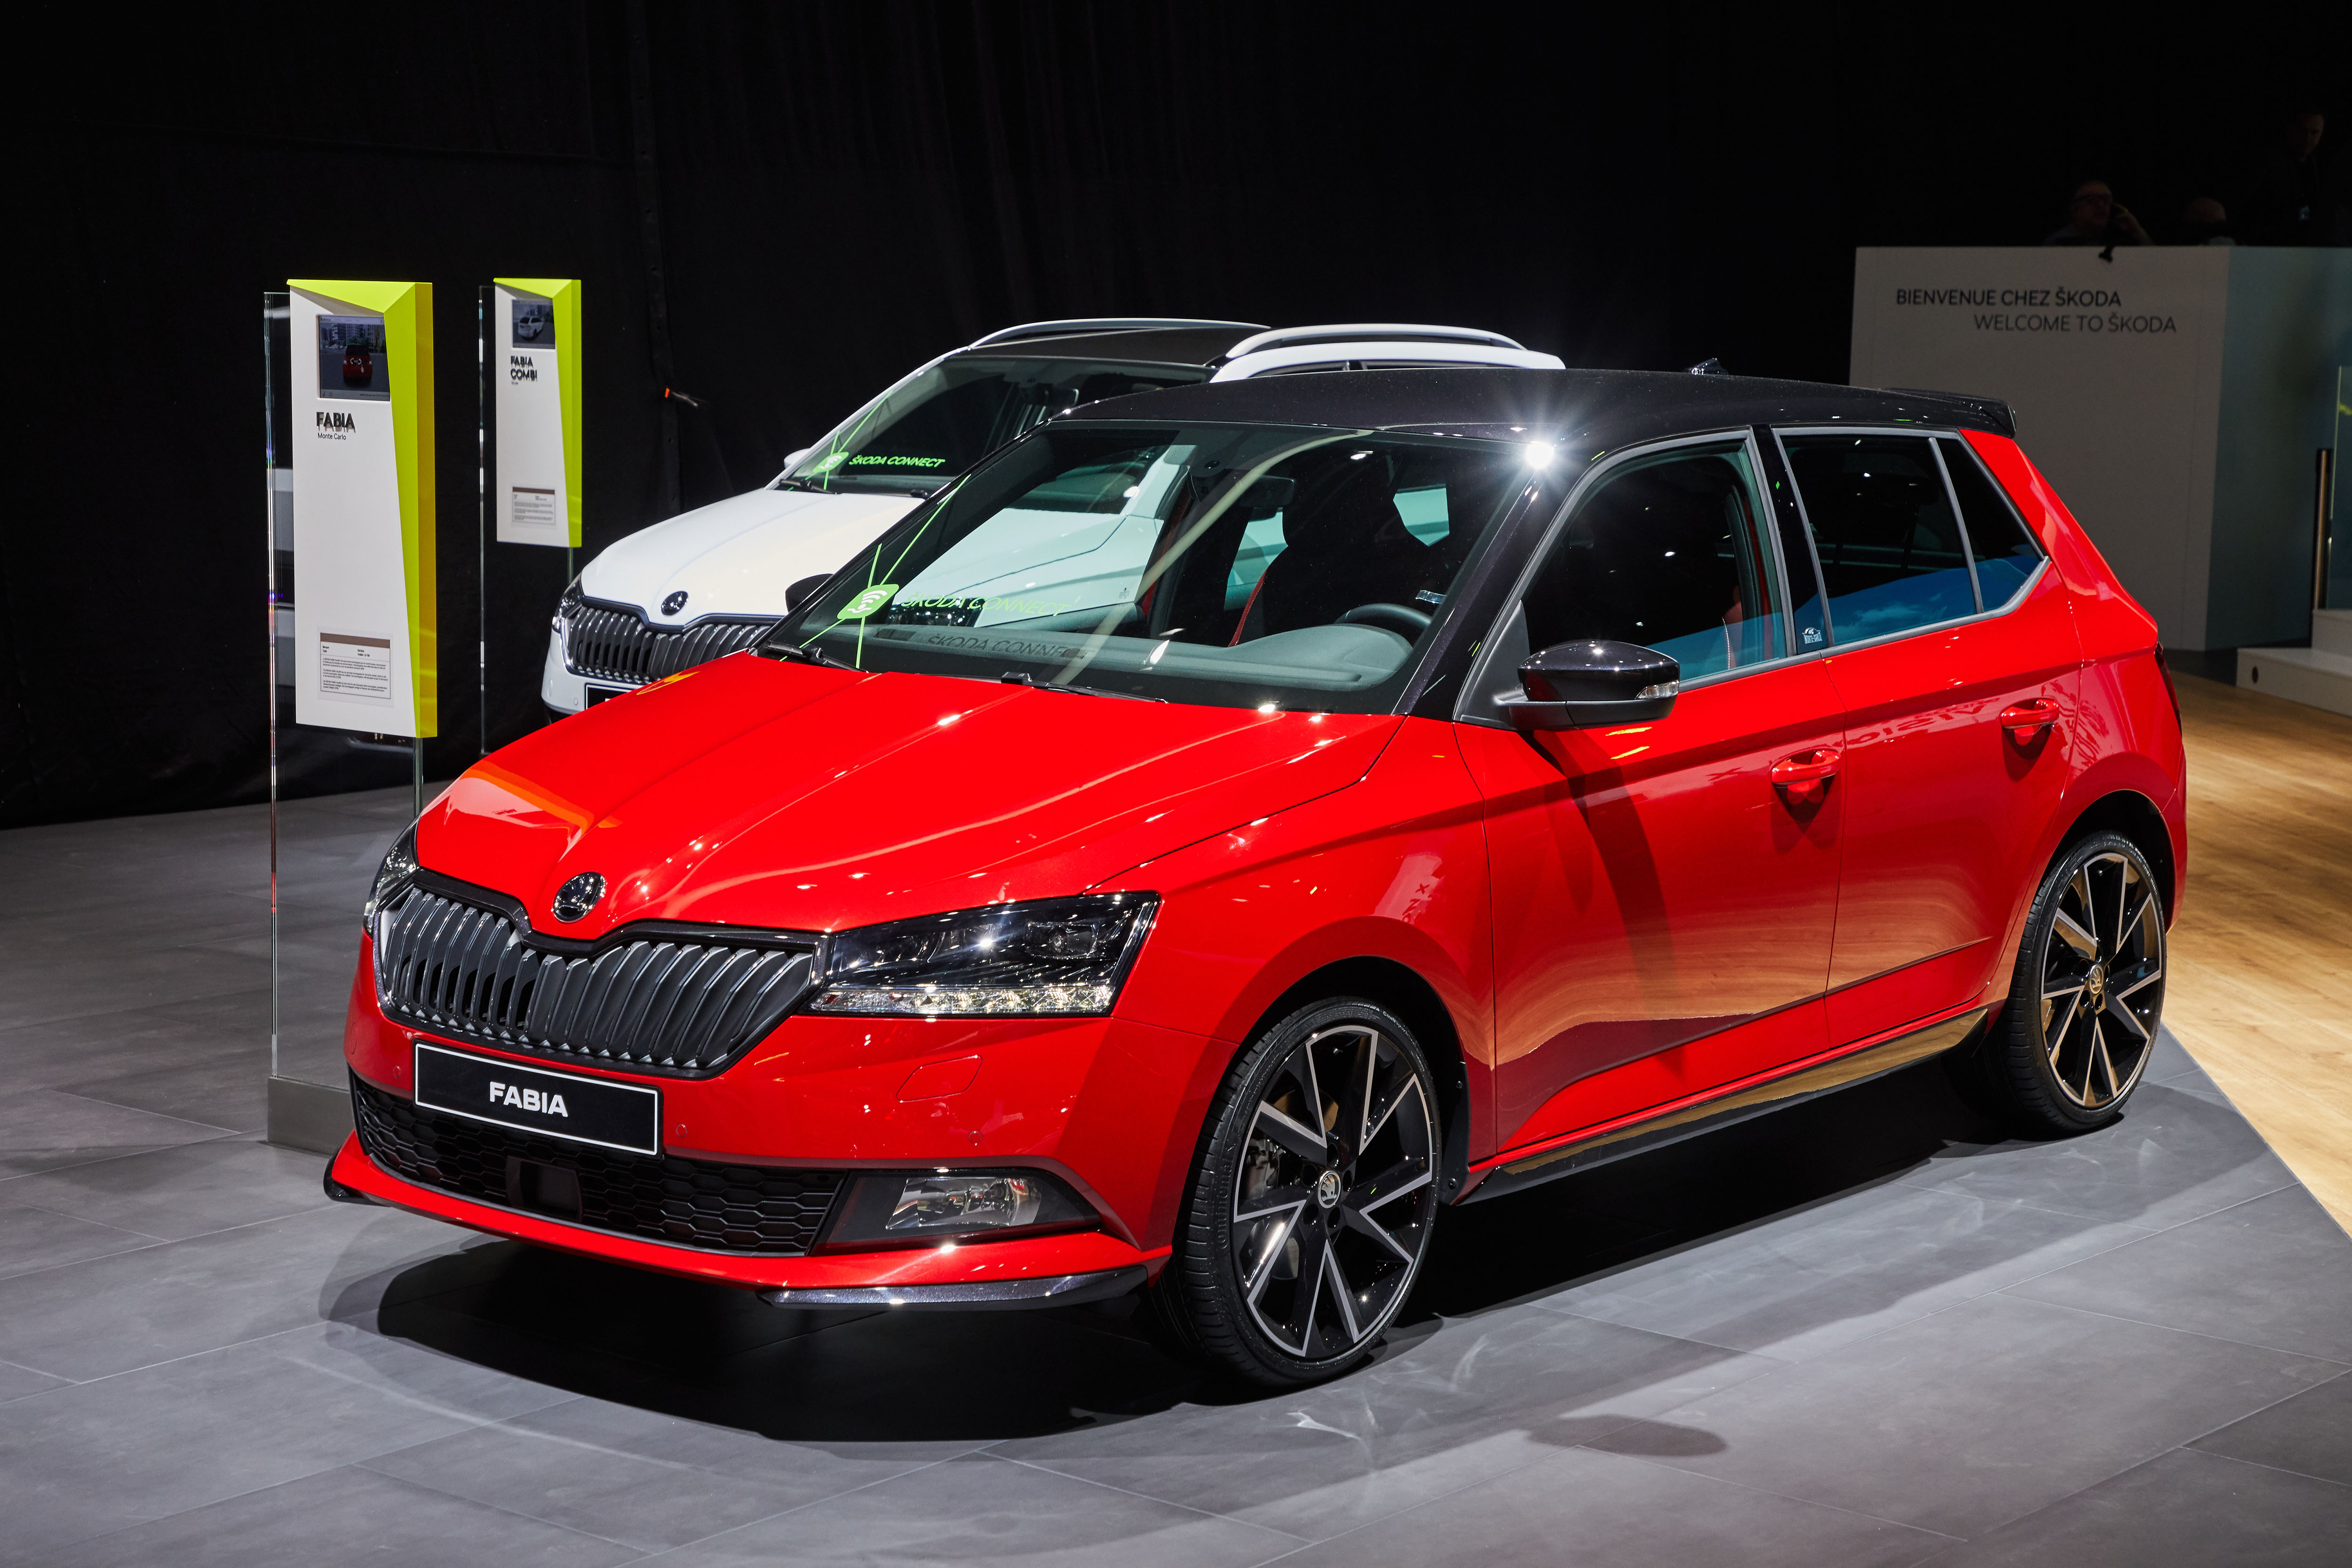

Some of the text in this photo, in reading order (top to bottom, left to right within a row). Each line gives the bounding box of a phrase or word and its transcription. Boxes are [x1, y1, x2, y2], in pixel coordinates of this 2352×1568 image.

[1896, 286, 2122, 307] BIENVENUE CHEZ ŠKODA
[1975, 312, 2177, 333] WELCOME TO ŠKODA
[510, 356, 533, 367] FABIA
[510, 368, 537, 380] COMBI
[316, 412, 355, 429] FABIA
[849, 455, 946, 467] ŠKODA CONNECT
[901, 592, 1072, 617] ŠKODA CONNECT
[489, 1081, 568, 1117] FABIA
